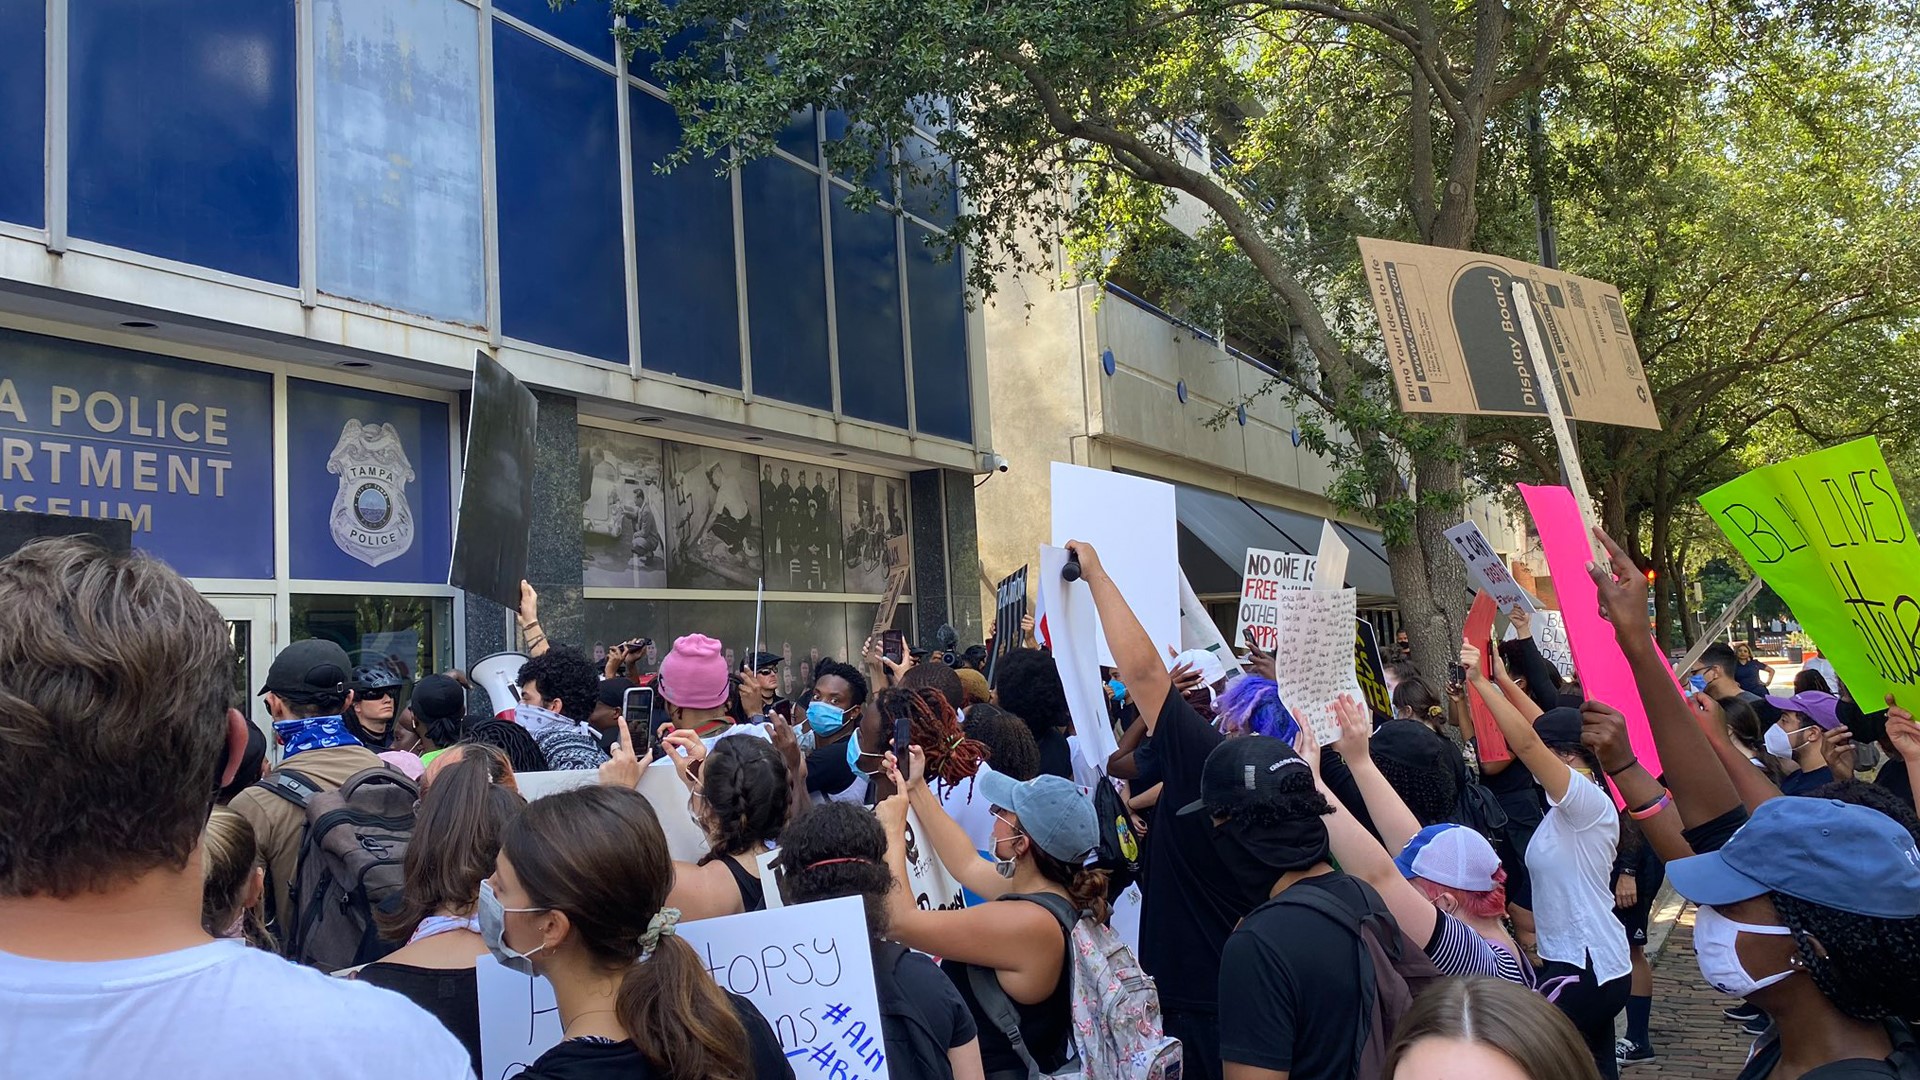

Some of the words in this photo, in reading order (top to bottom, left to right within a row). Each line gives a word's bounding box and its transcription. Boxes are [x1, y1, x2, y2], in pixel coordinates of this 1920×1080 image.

[1379, 284, 1388, 296] to
[1488, 275, 1515, 333] Board
[1383, 298, 1398, 333] Ideas
[1388, 267, 1424, 378] www.elmers.com
[1393, 334, 1406, 366] Your
[1403, 367, 1417, 402] Bring
[1508, 336, 1537, 406] Display
[0, 378, 28, 423] A
[51, 385, 228, 446] POLICE
[2, 437, 233, 498] RTMENT
[350, 466, 393, 482] TAMPA
[0, 494, 153, 533] SEUM
[1793, 468, 1906, 549] LIVES
[350, 529, 396, 546] POLICE
[1247, 553, 1271, 576] NO
[1274, 557, 1299, 580] ONE
[1244, 578, 1278, 601] FREE
[1240, 603, 1278, 626] OTHE
